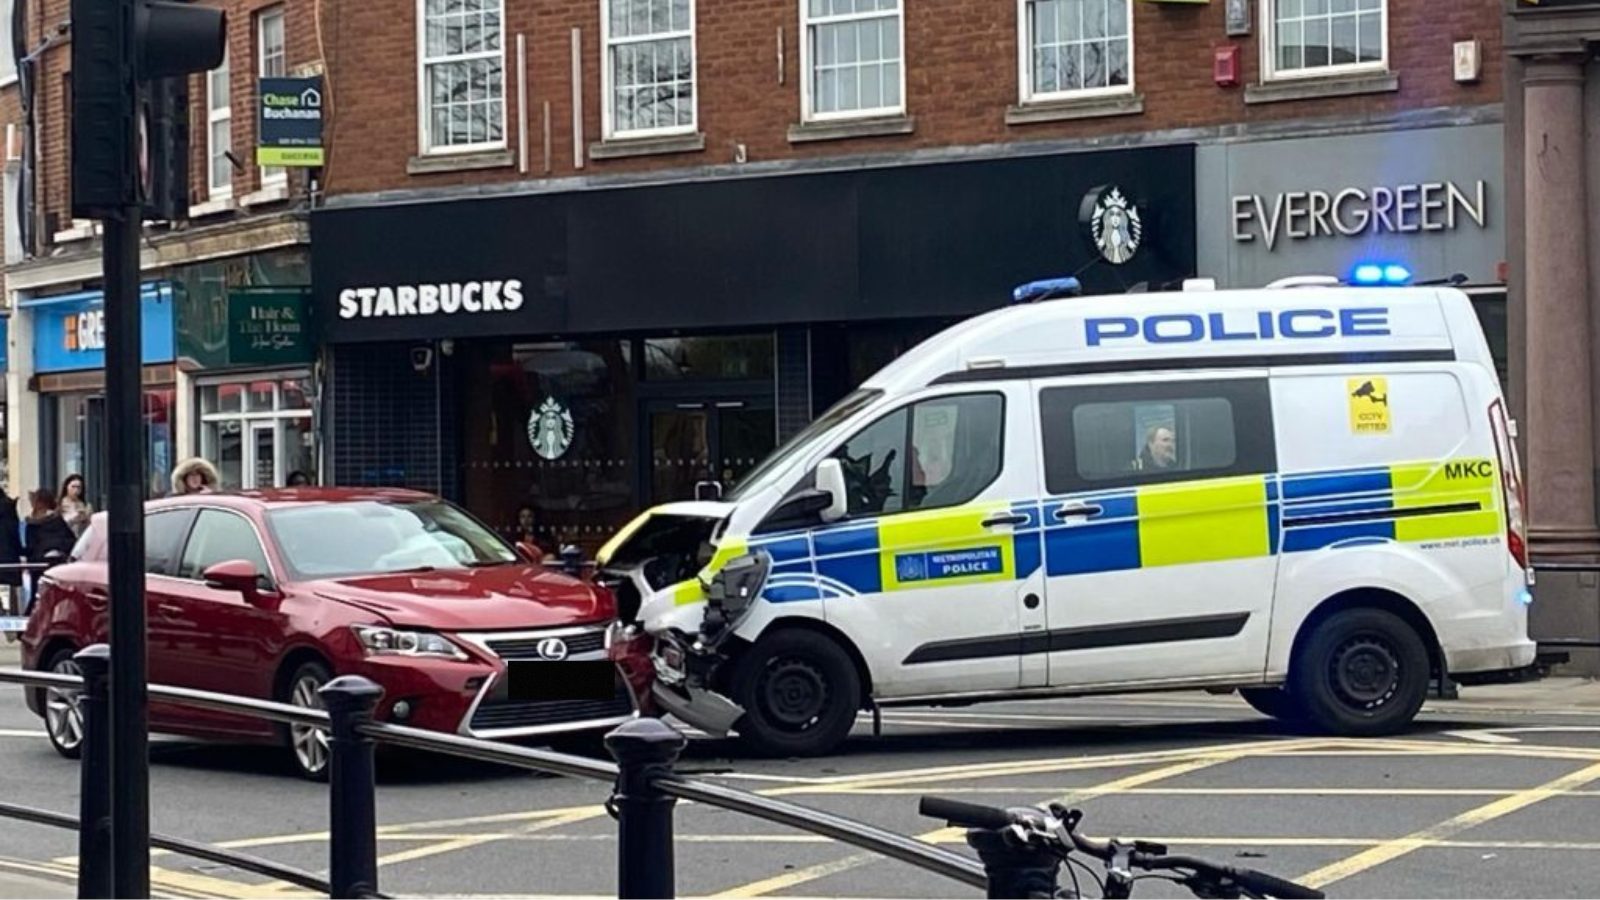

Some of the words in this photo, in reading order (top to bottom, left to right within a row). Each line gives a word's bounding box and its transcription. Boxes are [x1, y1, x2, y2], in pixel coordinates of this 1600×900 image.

[263, 93, 299, 106] Chase
[263, 107, 321, 119] Buchanan
[1232, 180, 1485, 250] EVERGREEN
[339, 279, 524, 319] STARBUCKS
[78, 310, 105, 351] GRE
[1084, 307, 1391, 346] POLICE
[1358, 412, 1383, 420] CCTV
[1444, 461, 1493, 480] MKC
[932, 549, 998, 563] METROPOLITAN
[942, 561, 990, 574] POLICE
